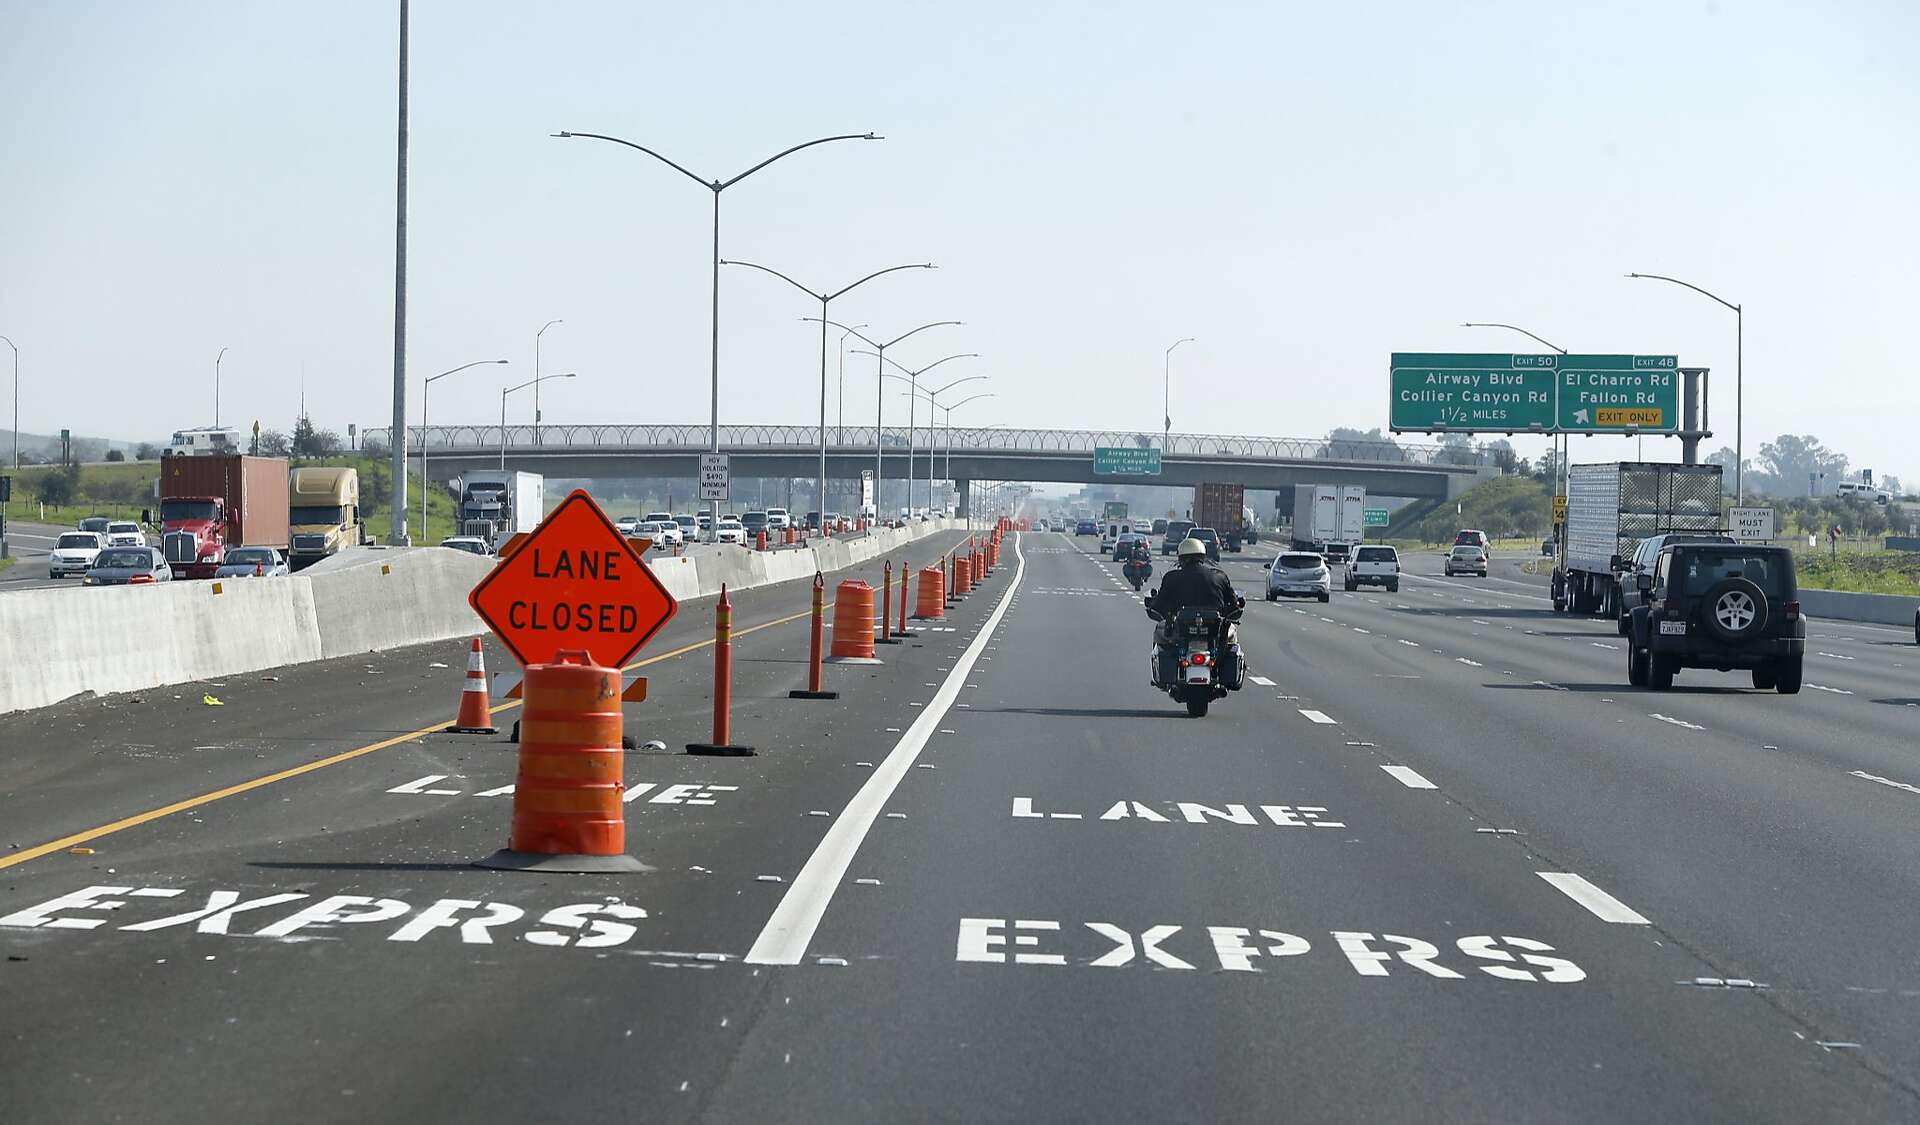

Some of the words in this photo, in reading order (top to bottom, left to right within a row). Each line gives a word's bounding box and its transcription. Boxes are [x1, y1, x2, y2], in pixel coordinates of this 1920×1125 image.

[1516, 357, 1533, 365] EXIT
[1537, 357, 1553, 366] 50
[1637, 358, 1654, 366] EXIT
[1658, 358, 1674, 367] 48
[1426, 373, 1481, 387] Airway
[1490, 373, 1524, 385] Blvd
[1566, 374, 1580, 386] El
[1589, 374, 1642, 386] Charro
[1650, 374, 1670, 386] Rd
[1401, 390, 1453, 402] Collier
[1462, 391, 1520, 405] Canyon
[1528, 391, 1547, 402] Rd
[1580, 391, 1628, 403] Fallon
[1636, 392, 1655, 403] Rd
[1473, 410, 1507, 419] MILES
[1598, 412, 1624, 421] EXIT
[1629, 413, 1658, 422] ONLY
[1739, 519, 1763, 527] MUST
[1741, 529, 1760, 537] EXIT
[533, 548, 621, 581] LANE
[508, 600, 638, 634] CLOSED
[1011, 797, 1346, 829] LANE
[0, 885, 649, 949] EXPRS
[956, 918, 1587, 984] EXPRS
